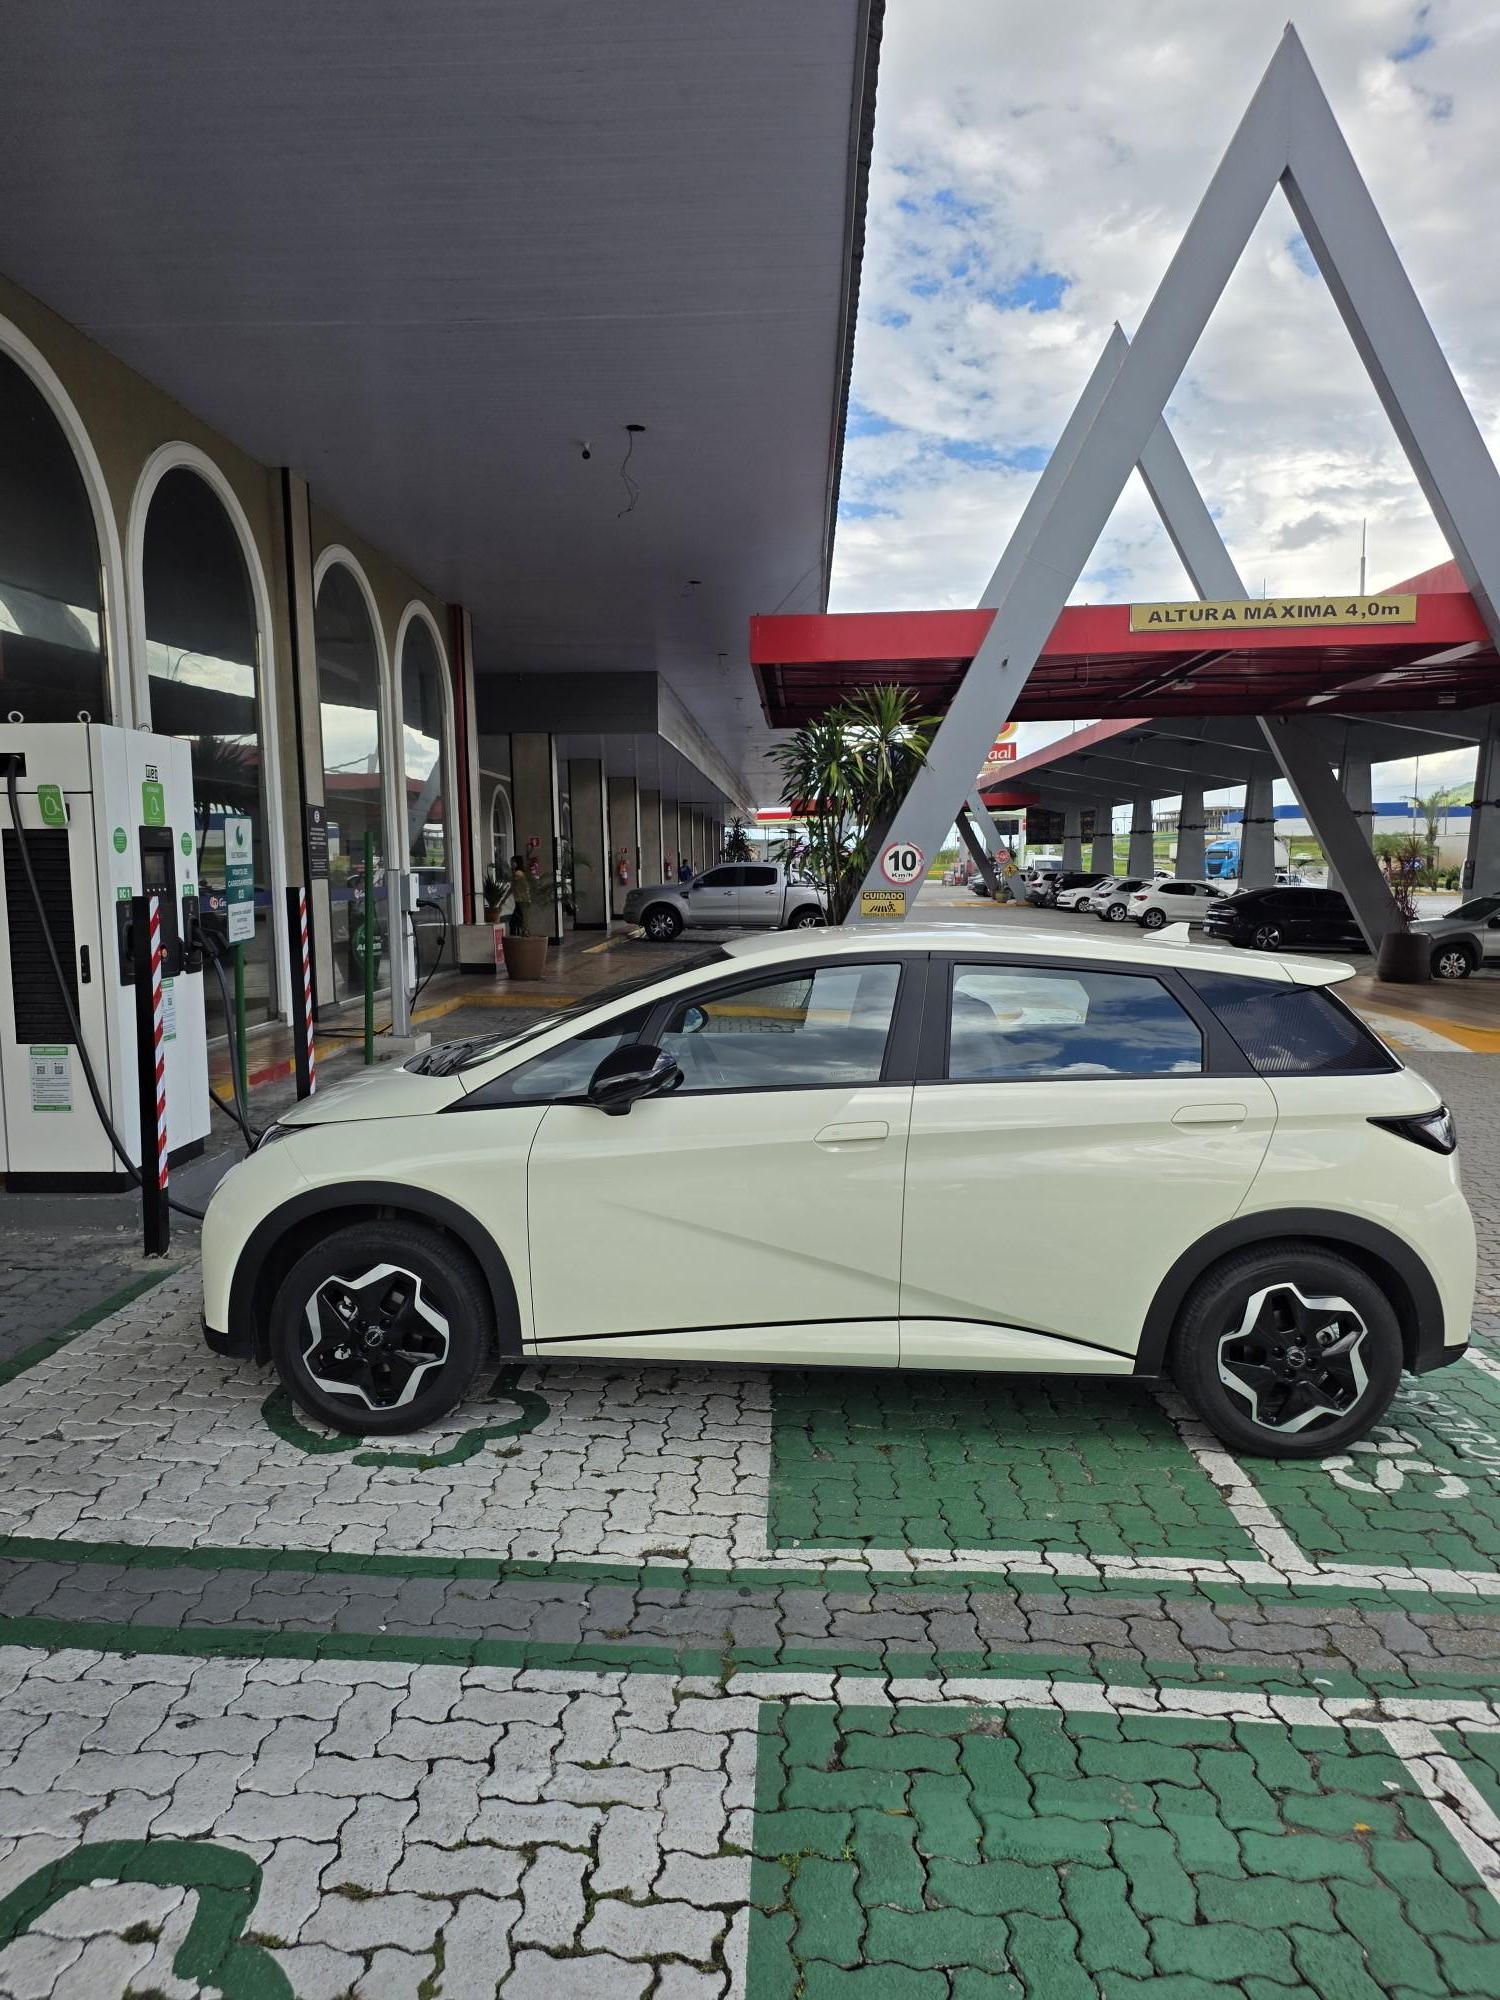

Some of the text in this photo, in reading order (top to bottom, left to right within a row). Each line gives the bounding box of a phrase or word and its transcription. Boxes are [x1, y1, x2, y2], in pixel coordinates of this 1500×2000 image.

[1148, 602, 1401, 623] ALTURA MÁXIMA 4,0m
[987, 744, 1012, 760] aal
[888, 850, 917, 871] 10
[863, 892, 904, 900] CUIDADO
